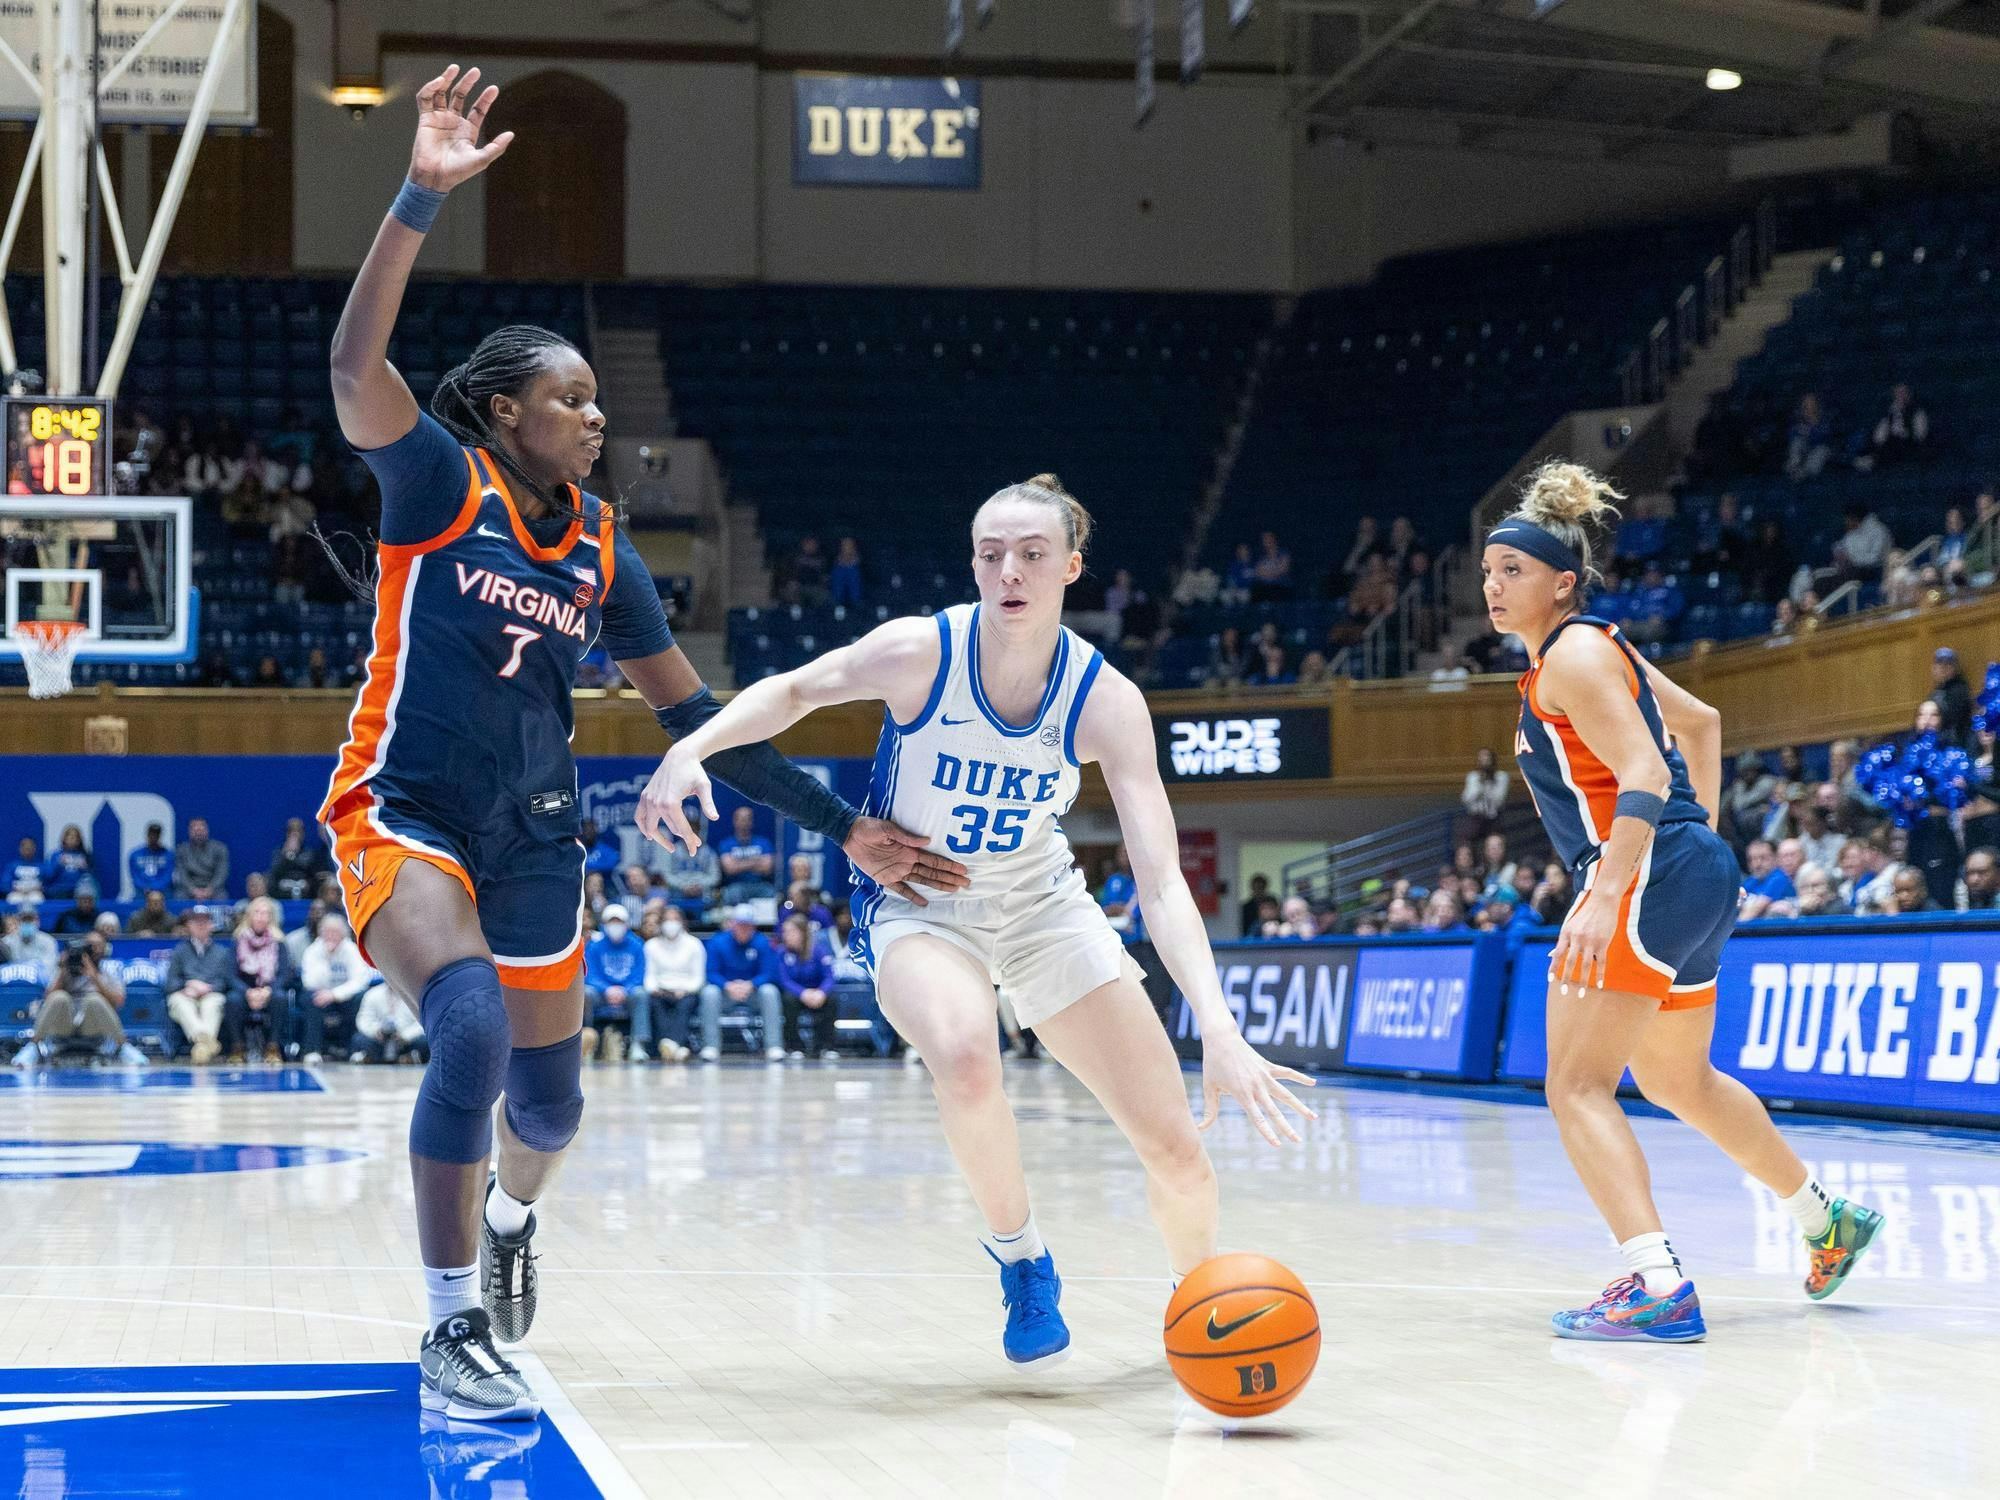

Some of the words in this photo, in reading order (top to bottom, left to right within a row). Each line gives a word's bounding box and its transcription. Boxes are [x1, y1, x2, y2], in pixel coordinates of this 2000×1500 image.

[808, 106, 966, 159] DUKE
[31, 406, 101, 440] 8:42
[43, 439, 91, 495] 18
[455, 561, 586, 642] VIRGINIA
[498, 623, 543, 679] 7
[1170, 718, 1282, 751] DUDE
[931, 751, 1061, 803] DUKE
[1170, 747, 1282, 776] WIPES
[945, 804, 1031, 854] 35
[1738, 962, 1920, 1080] DUKE
